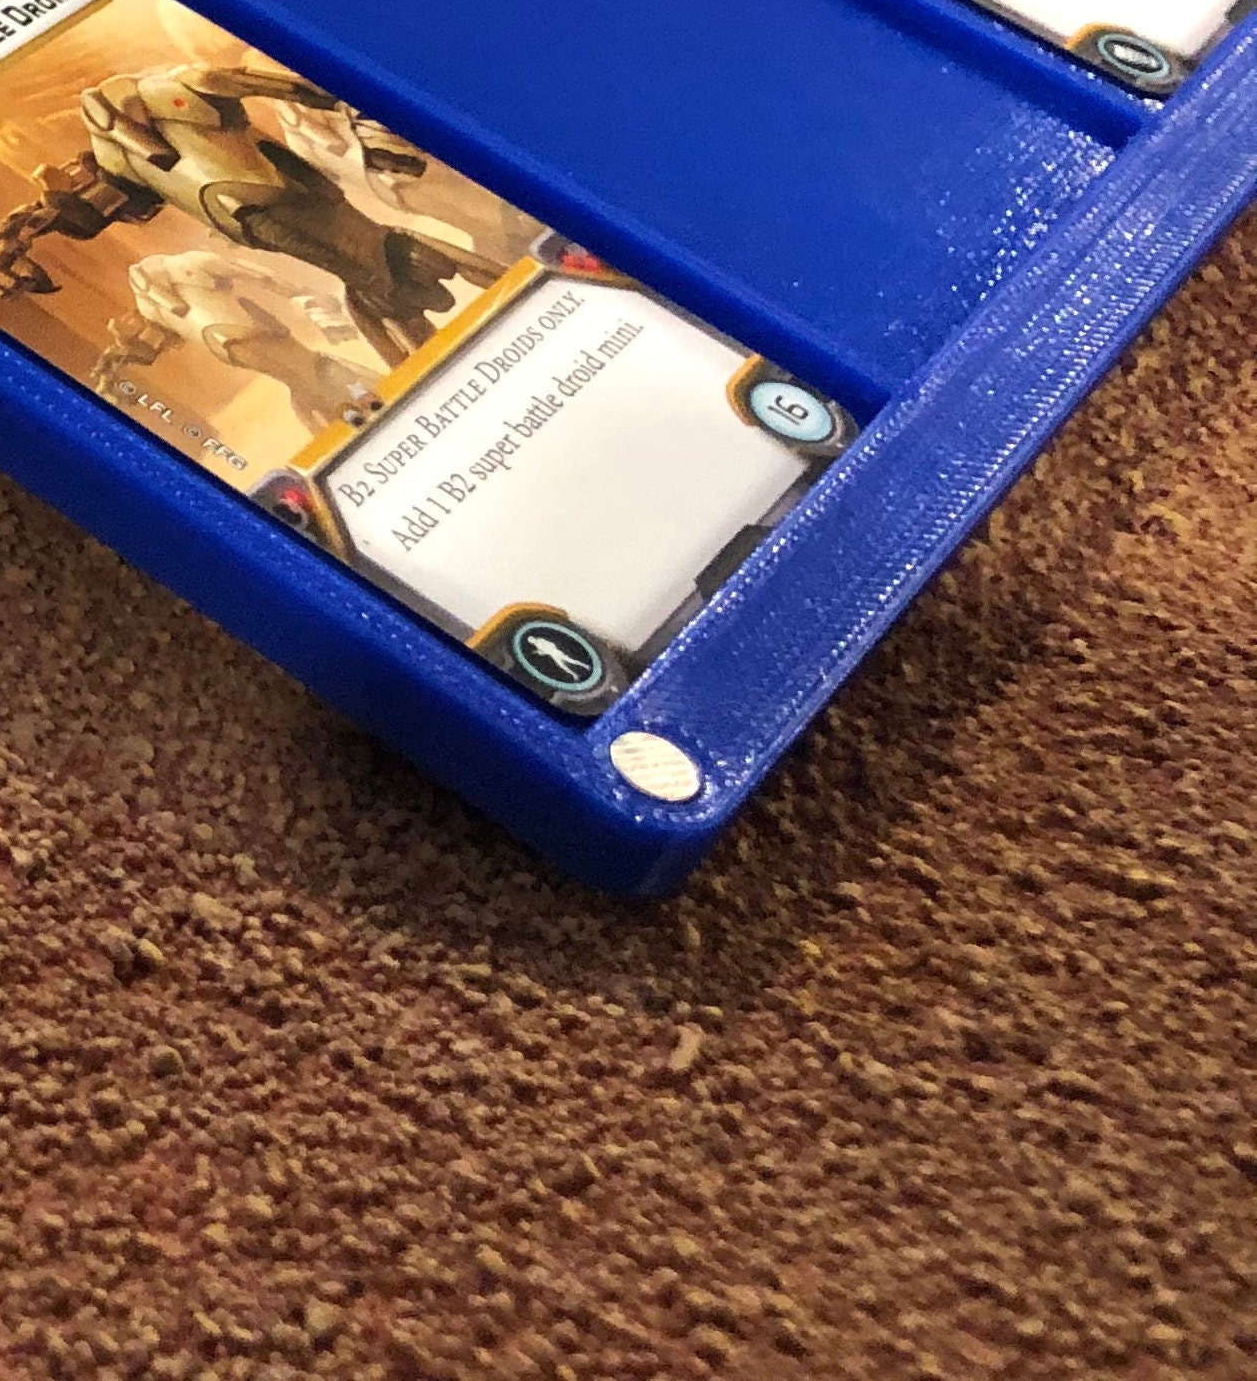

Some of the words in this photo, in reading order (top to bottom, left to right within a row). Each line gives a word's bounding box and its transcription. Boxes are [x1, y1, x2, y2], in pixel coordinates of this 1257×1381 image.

[597, 318, 645, 360] mini.
[552, 349, 607, 398] droid
[338, 481, 376, 508] B2
[363, 434, 428, 485] SUPER
[415, 378, 487, 439] BATTLE
[473, 326, 545, 385] DROIDS
[537, 290, 585, 332] ONLY.
[503, 395, 565, 439] battle
[767, 394, 810, 426] 16
[469, 432, 521, 481] super
[426, 495, 452, 516] 1
[437, 473, 477, 503] B2
[391, 505, 440, 552] Add
